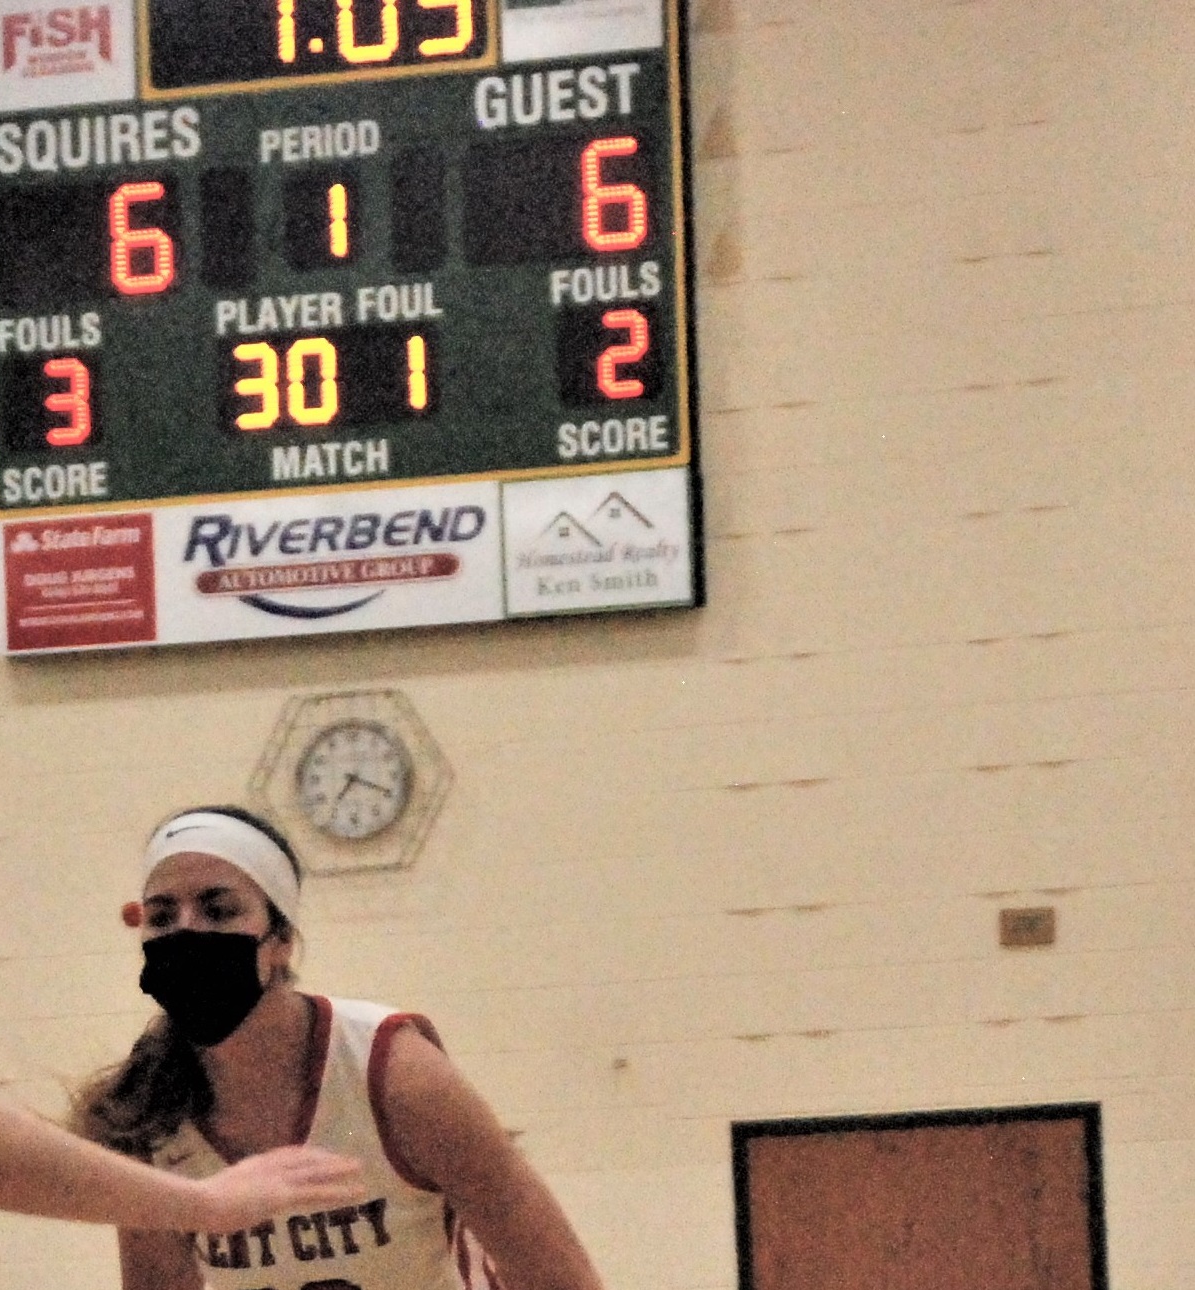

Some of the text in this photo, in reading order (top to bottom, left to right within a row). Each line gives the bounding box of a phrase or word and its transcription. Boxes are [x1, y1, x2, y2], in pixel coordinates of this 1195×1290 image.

[474, 62, 642, 130] GUEST
[259, 120, 381, 164] PERIOD
[328, 182, 349, 259] 1
[581, 136, 648, 252] 6
[109, 180, 174, 296] 6
[215, 282, 444, 336] PLAYER FOUL
[550, 263, 662, 305] FOULS
[233, 336, 339, 431] 30
[407, 335, 427, 412] 1
[596, 308, 652, 401] 2
[42, 357, 93, 448] 3
[558, 416, 670, 459] SCORE
[2, 462, 108, 503] SCORE
[271, 439, 390, 481] MATCH
[183, 504, 487, 567] RIVERBEND
[184, 1197, 392, 1270] ENT CITY
